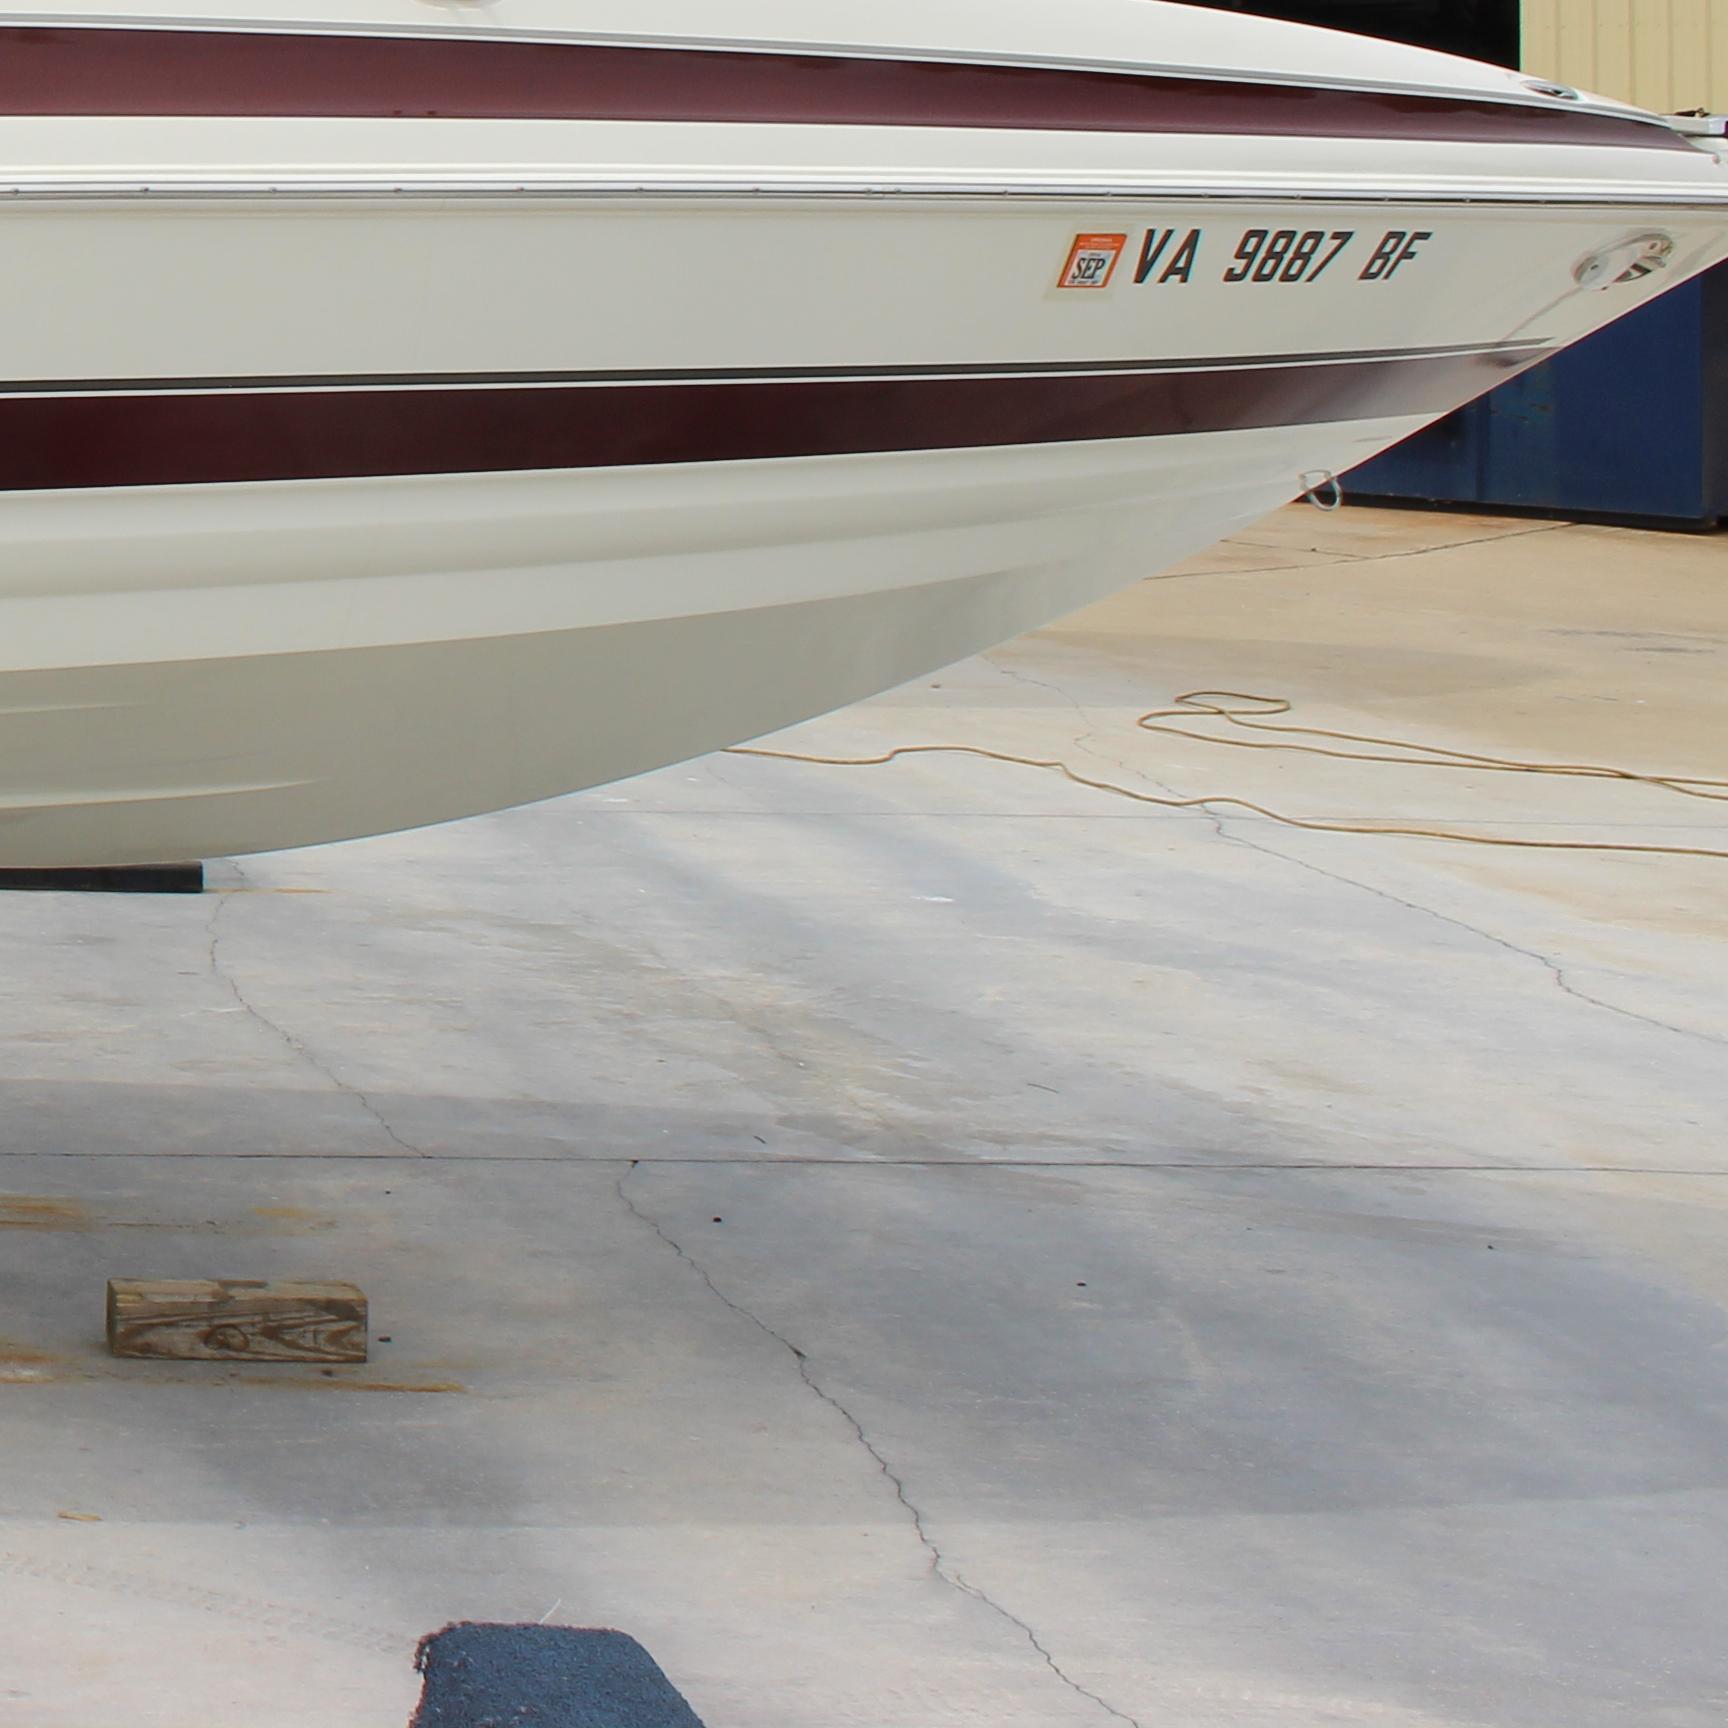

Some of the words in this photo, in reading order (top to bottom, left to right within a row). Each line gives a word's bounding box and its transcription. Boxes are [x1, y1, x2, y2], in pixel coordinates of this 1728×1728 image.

[1072, 257, 1106, 279] SEP
[1133, 229, 1201, 284] VA
[1222, 229, 1354, 282] 9887
[1357, 230, 1433, 280] BF
